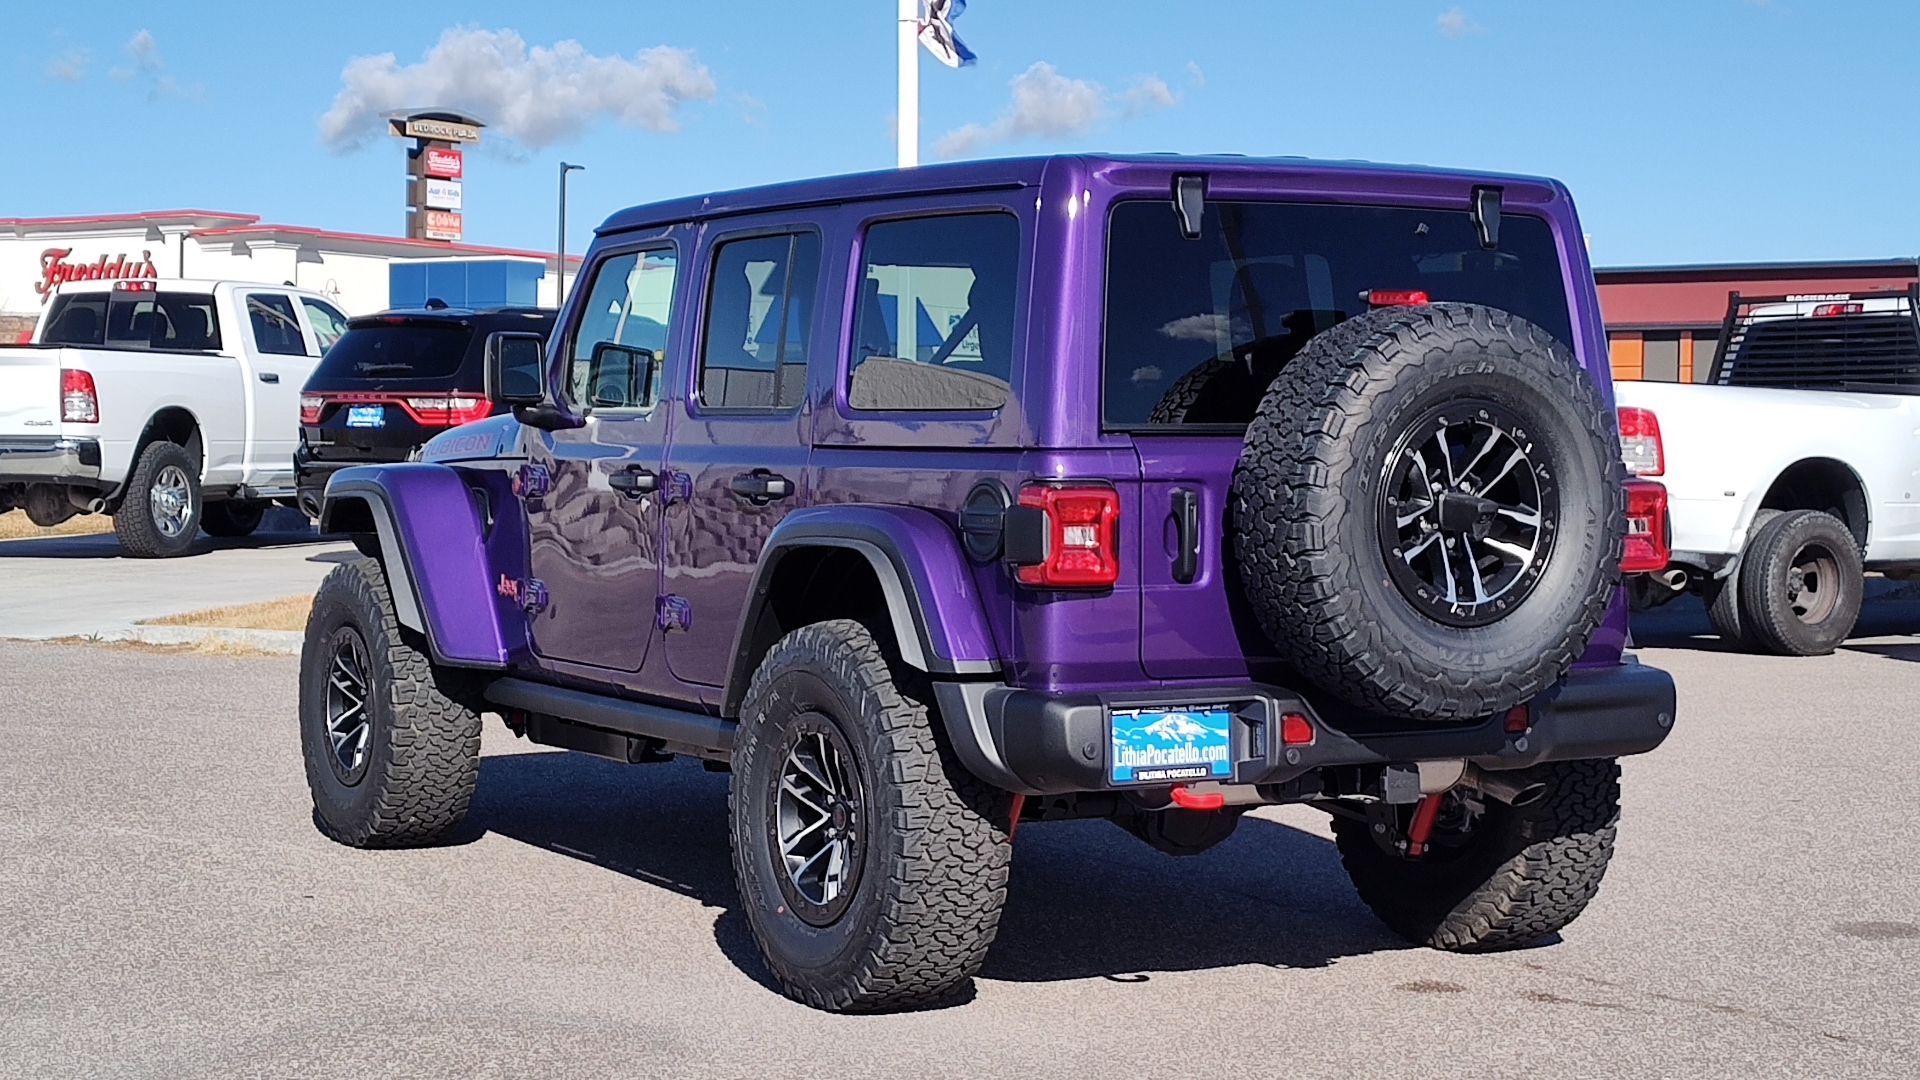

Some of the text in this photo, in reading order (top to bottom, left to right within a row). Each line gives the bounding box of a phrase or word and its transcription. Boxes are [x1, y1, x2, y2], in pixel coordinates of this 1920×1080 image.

[413, 122, 478, 140] BEDROCK PLAZA
[34, 248, 157, 298] Freddy's
[425, 433, 493, 457] RUBICON
[1114, 741, 1228, 768] LithiaPocatello.com
[1166, 767, 1207, 778] POCATELLO
